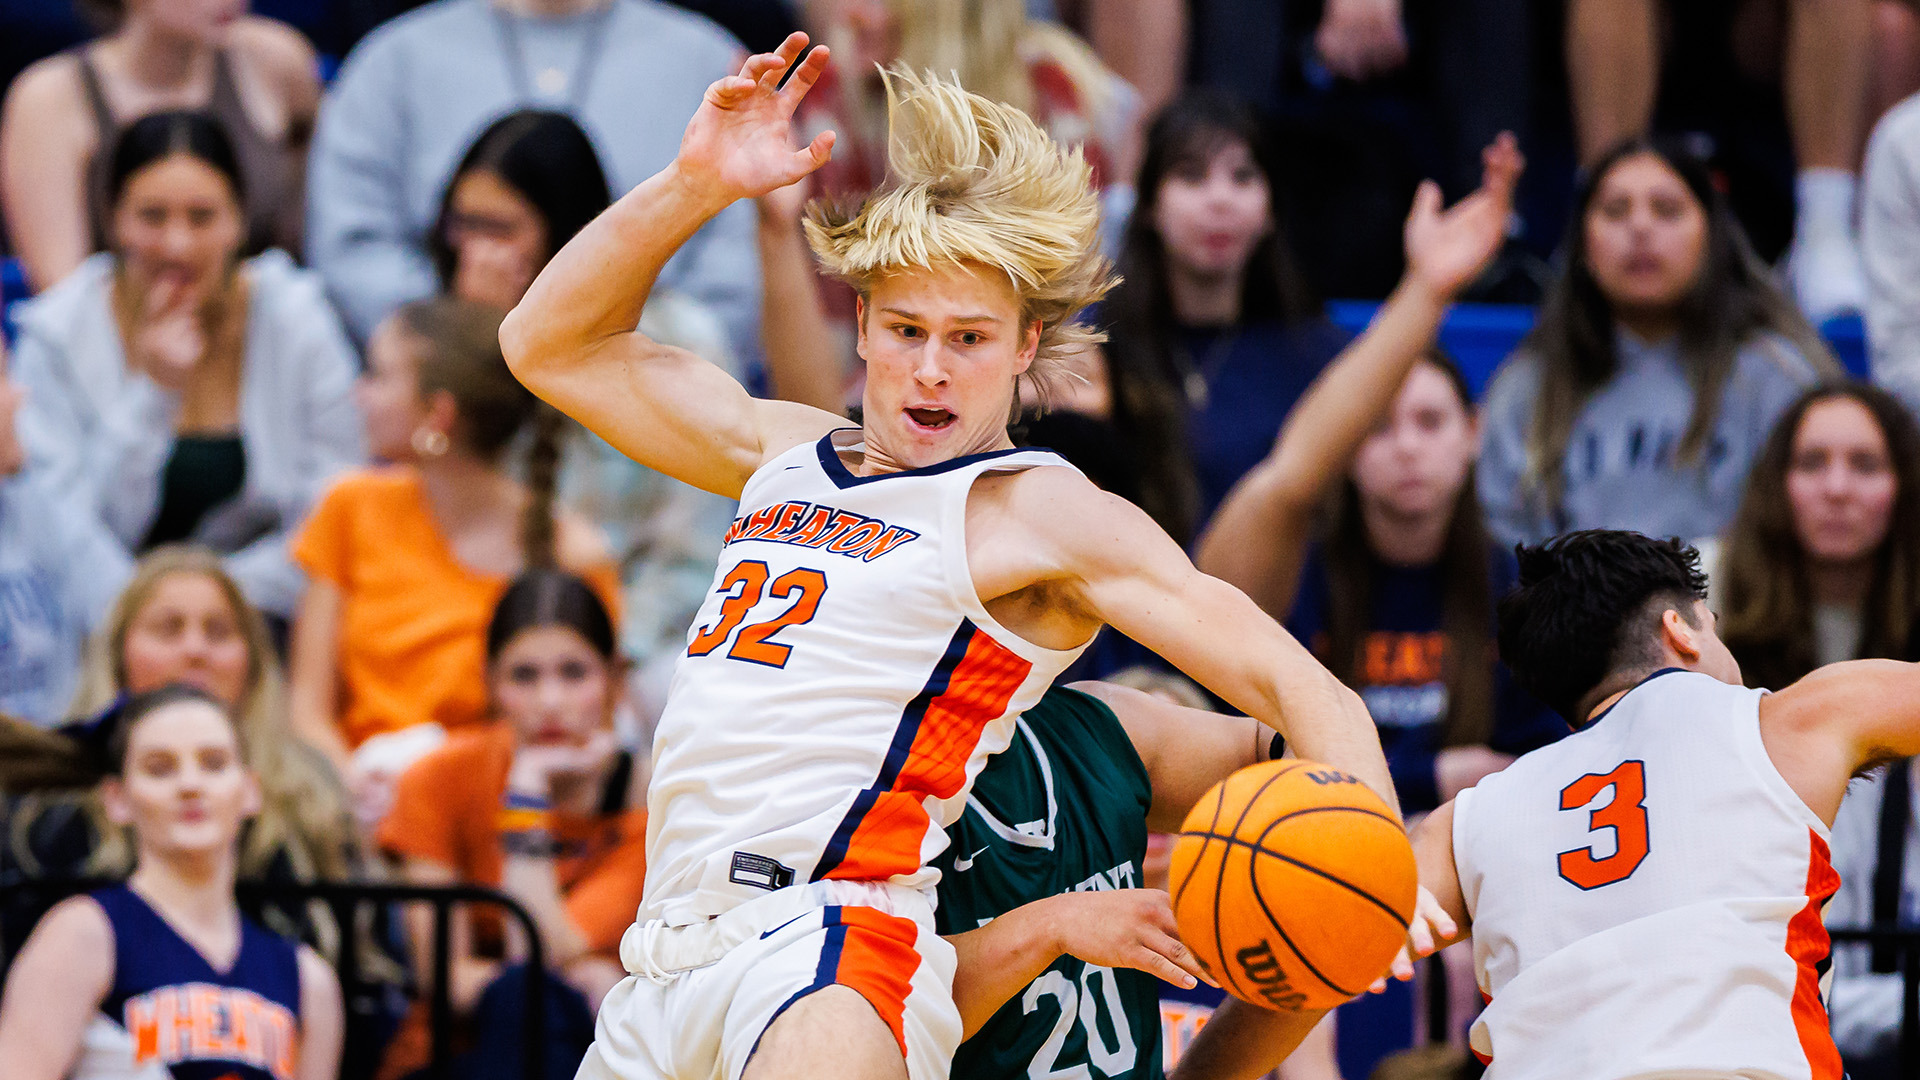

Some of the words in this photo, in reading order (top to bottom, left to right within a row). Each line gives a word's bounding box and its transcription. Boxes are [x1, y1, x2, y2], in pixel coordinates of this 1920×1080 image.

[687, 559, 828, 670] 32
[1557, 759, 1651, 892] 3
[1022, 961, 1138, 1080] 20
